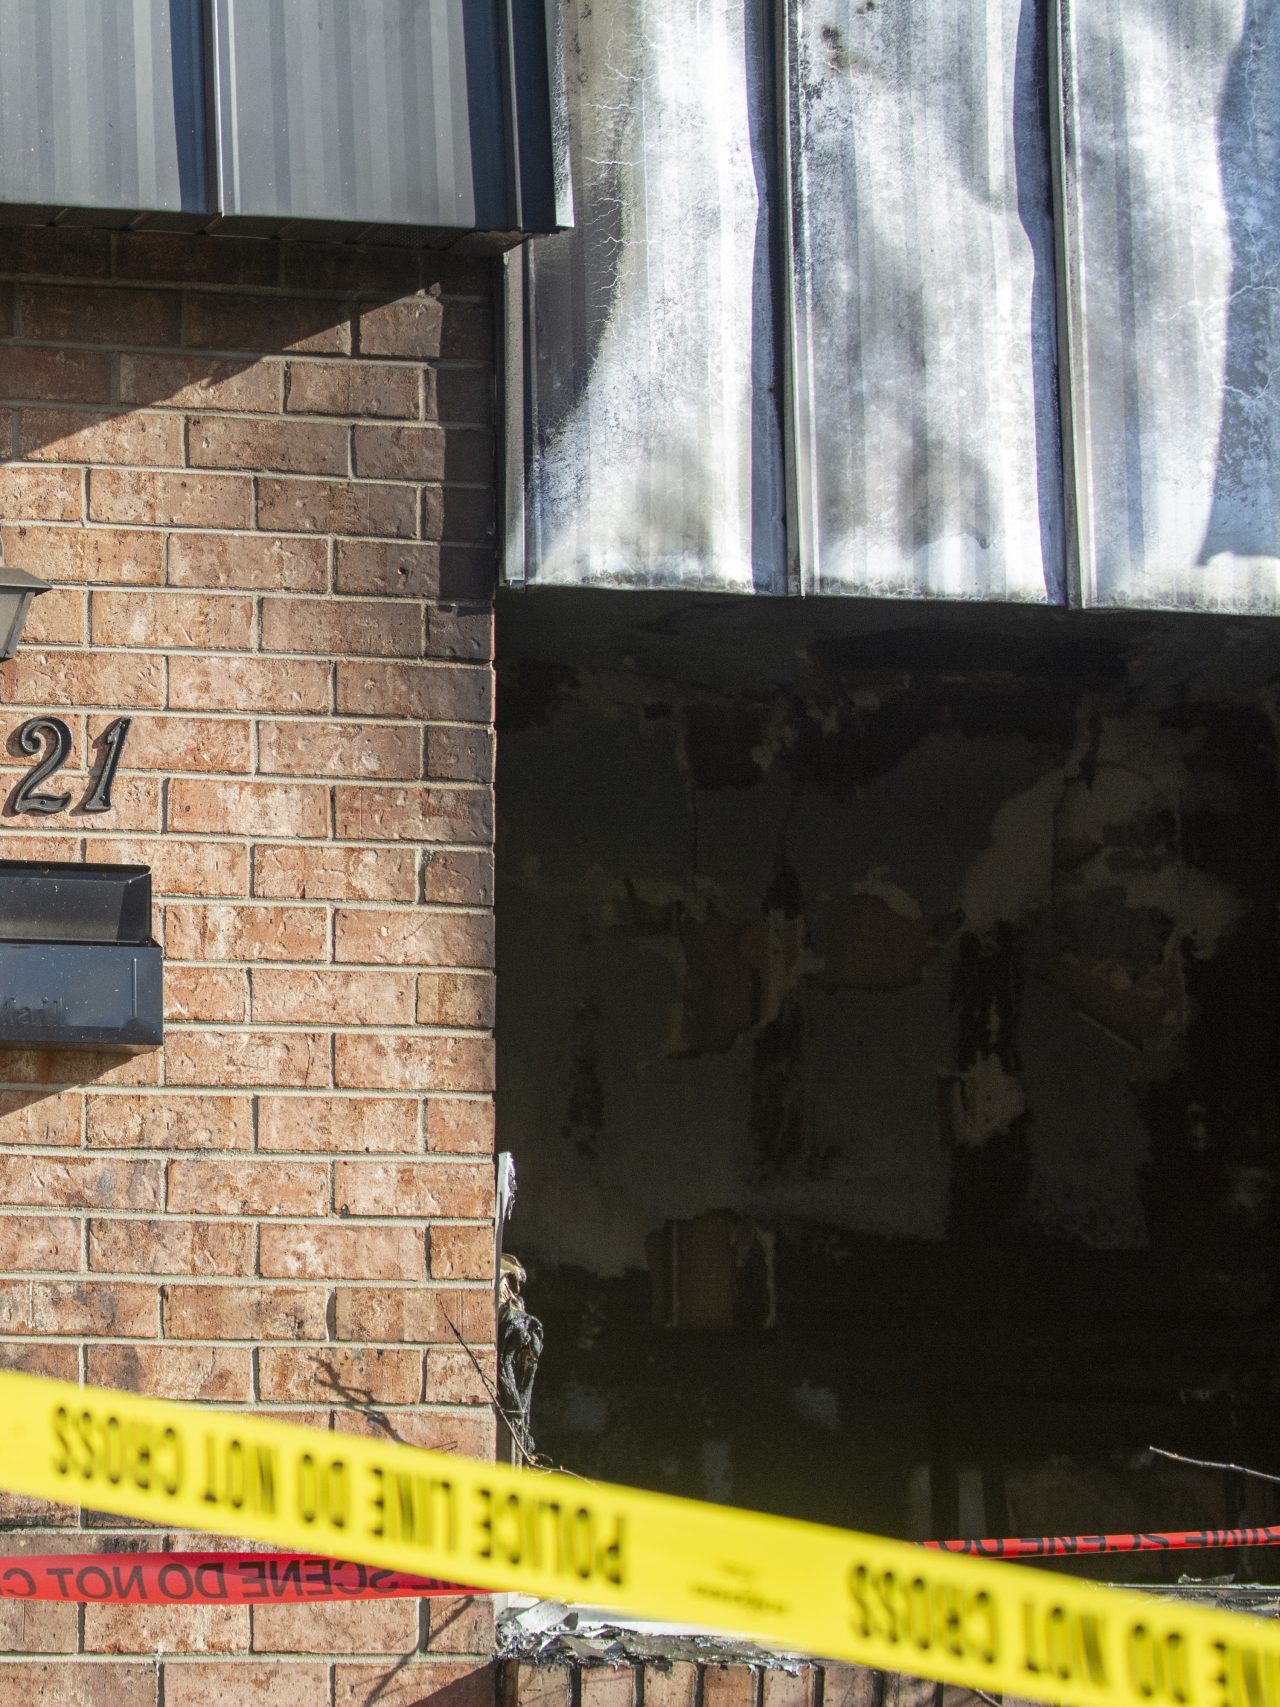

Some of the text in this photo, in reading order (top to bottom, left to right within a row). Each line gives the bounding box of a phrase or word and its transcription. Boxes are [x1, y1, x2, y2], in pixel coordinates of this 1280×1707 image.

[52, 1404, 185, 1497] CROSS
[201, 1434, 277, 1517] NOT
[298, 1452, 351, 1530] DO
[478, 1486, 629, 1588] POLICE
